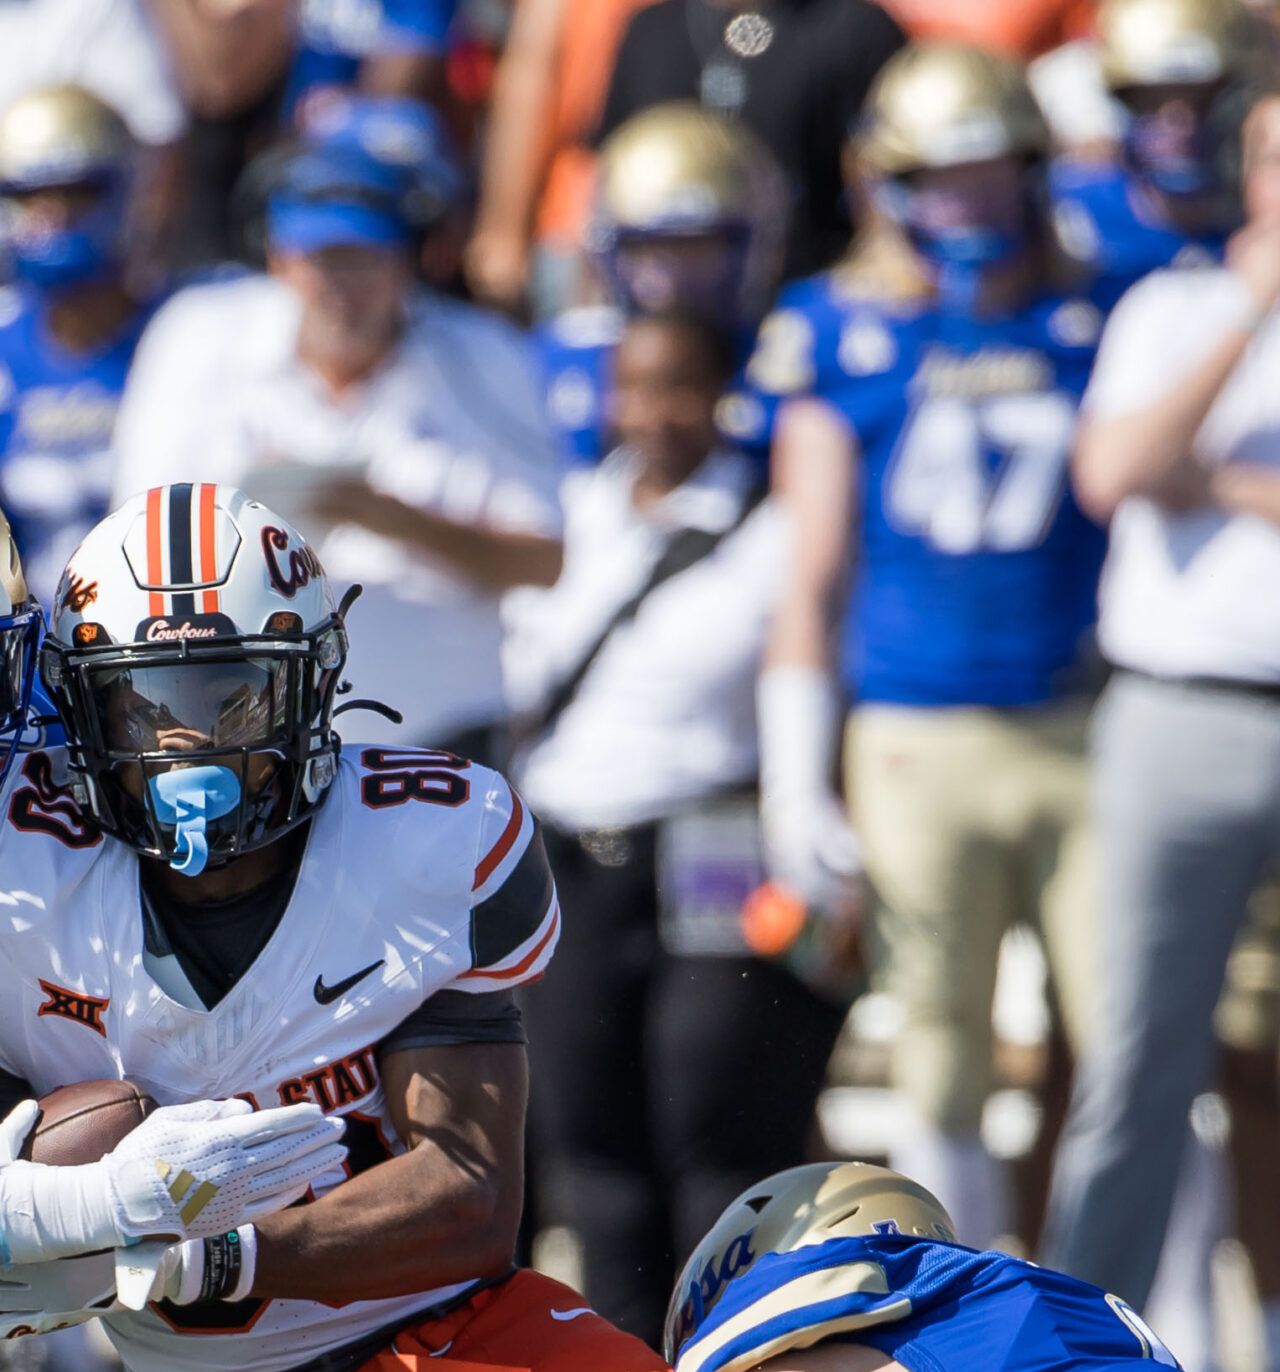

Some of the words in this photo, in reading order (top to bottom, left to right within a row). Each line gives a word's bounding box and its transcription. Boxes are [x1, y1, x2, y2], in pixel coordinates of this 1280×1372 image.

[882, 393, 1074, 554] 47
[361, 748, 472, 810] 80
[276, 1043, 380, 1116] STAT
